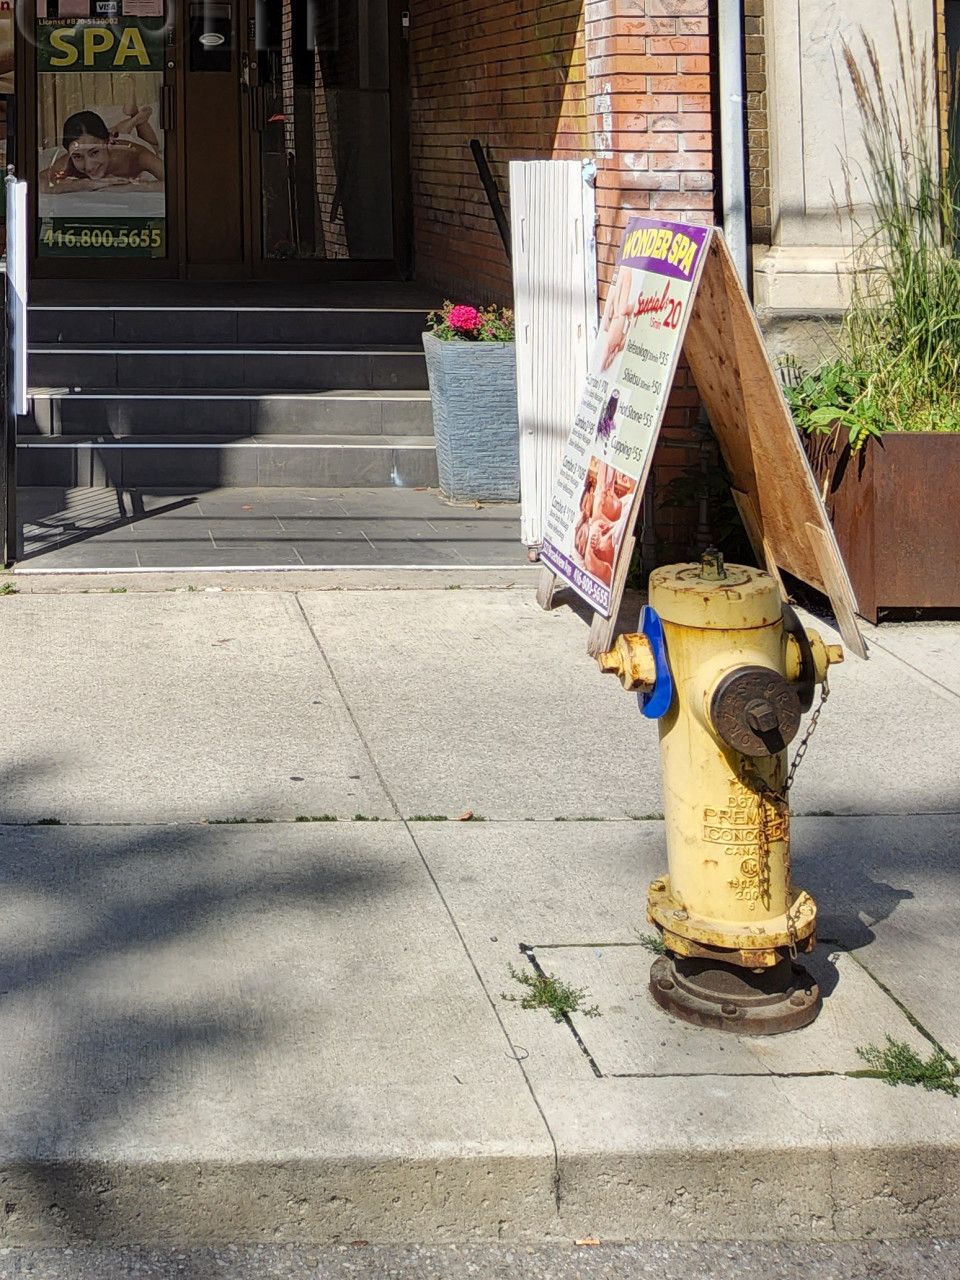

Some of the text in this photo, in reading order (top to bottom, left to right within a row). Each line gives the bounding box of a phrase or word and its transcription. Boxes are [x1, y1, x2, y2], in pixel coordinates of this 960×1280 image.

[97, 2, 117, 11] VISA
[49, 27, 151, 67] SPA
[43, 229, 161, 247] 416.800.5655
[622, 228, 698, 276] WONDER SPA
[634, 279, 670, 328] Special
[626, 404, 643, 425] Stone
[643, 410, 653, 429] $55
[610, 434, 633, 462] Cupping
[632, 443, 643, 462] $55
